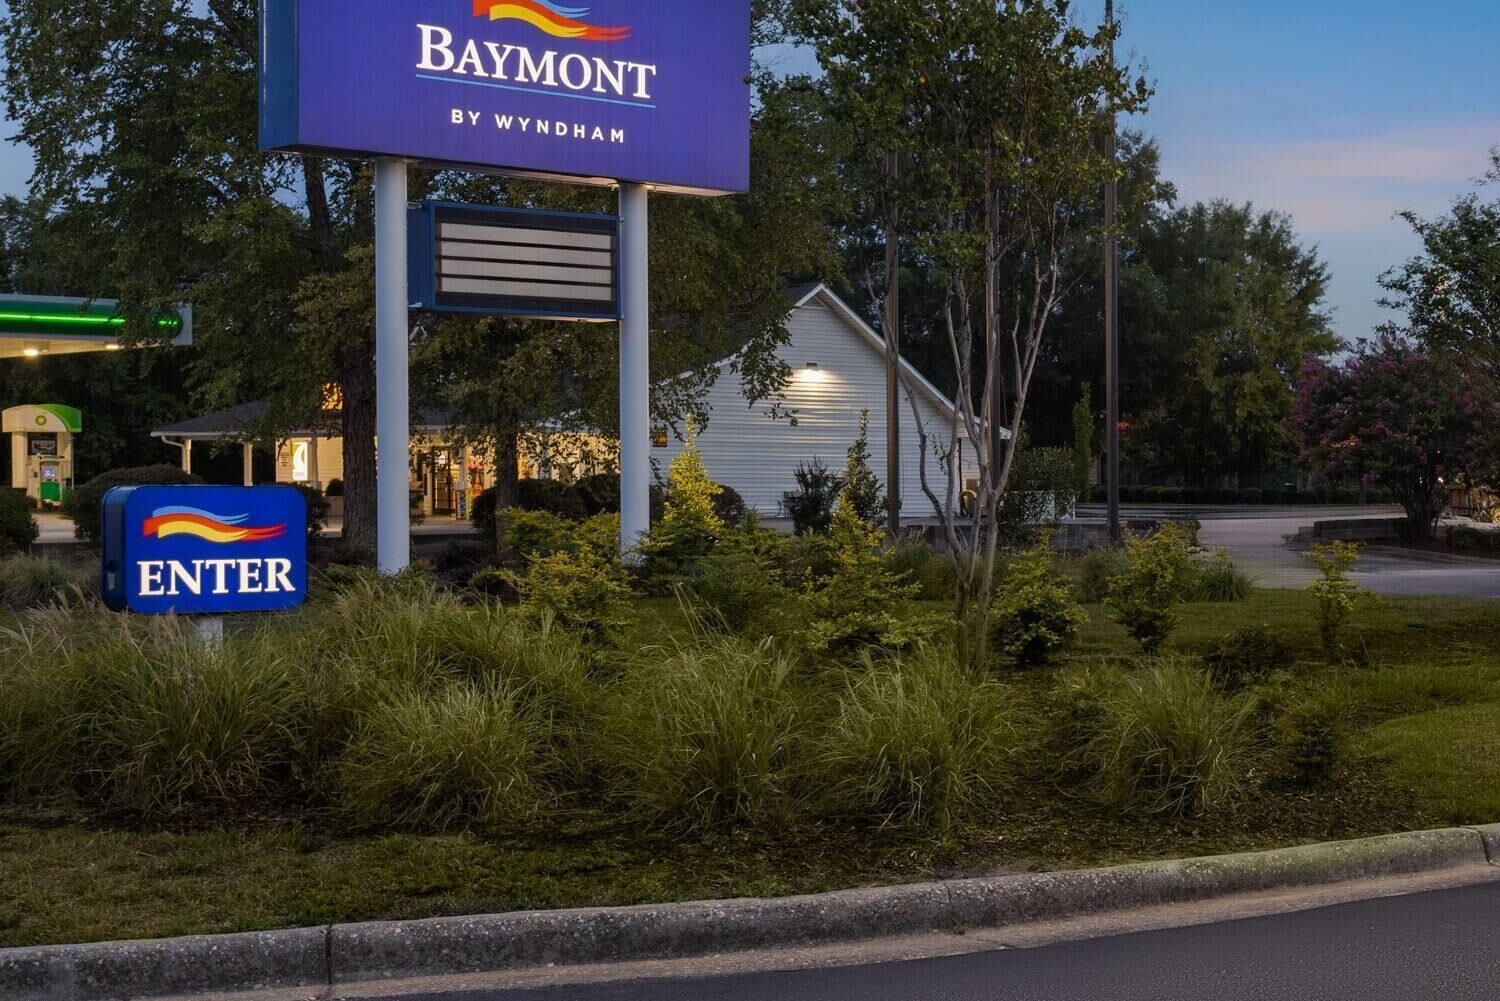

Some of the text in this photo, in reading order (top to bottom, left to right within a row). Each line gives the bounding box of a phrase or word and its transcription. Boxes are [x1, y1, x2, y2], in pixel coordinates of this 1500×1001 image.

[415, 23, 657, 100] BAYMONT
[451, 108, 626, 144] BY WYNDHAM
[136, 557, 296, 597] ENTER
